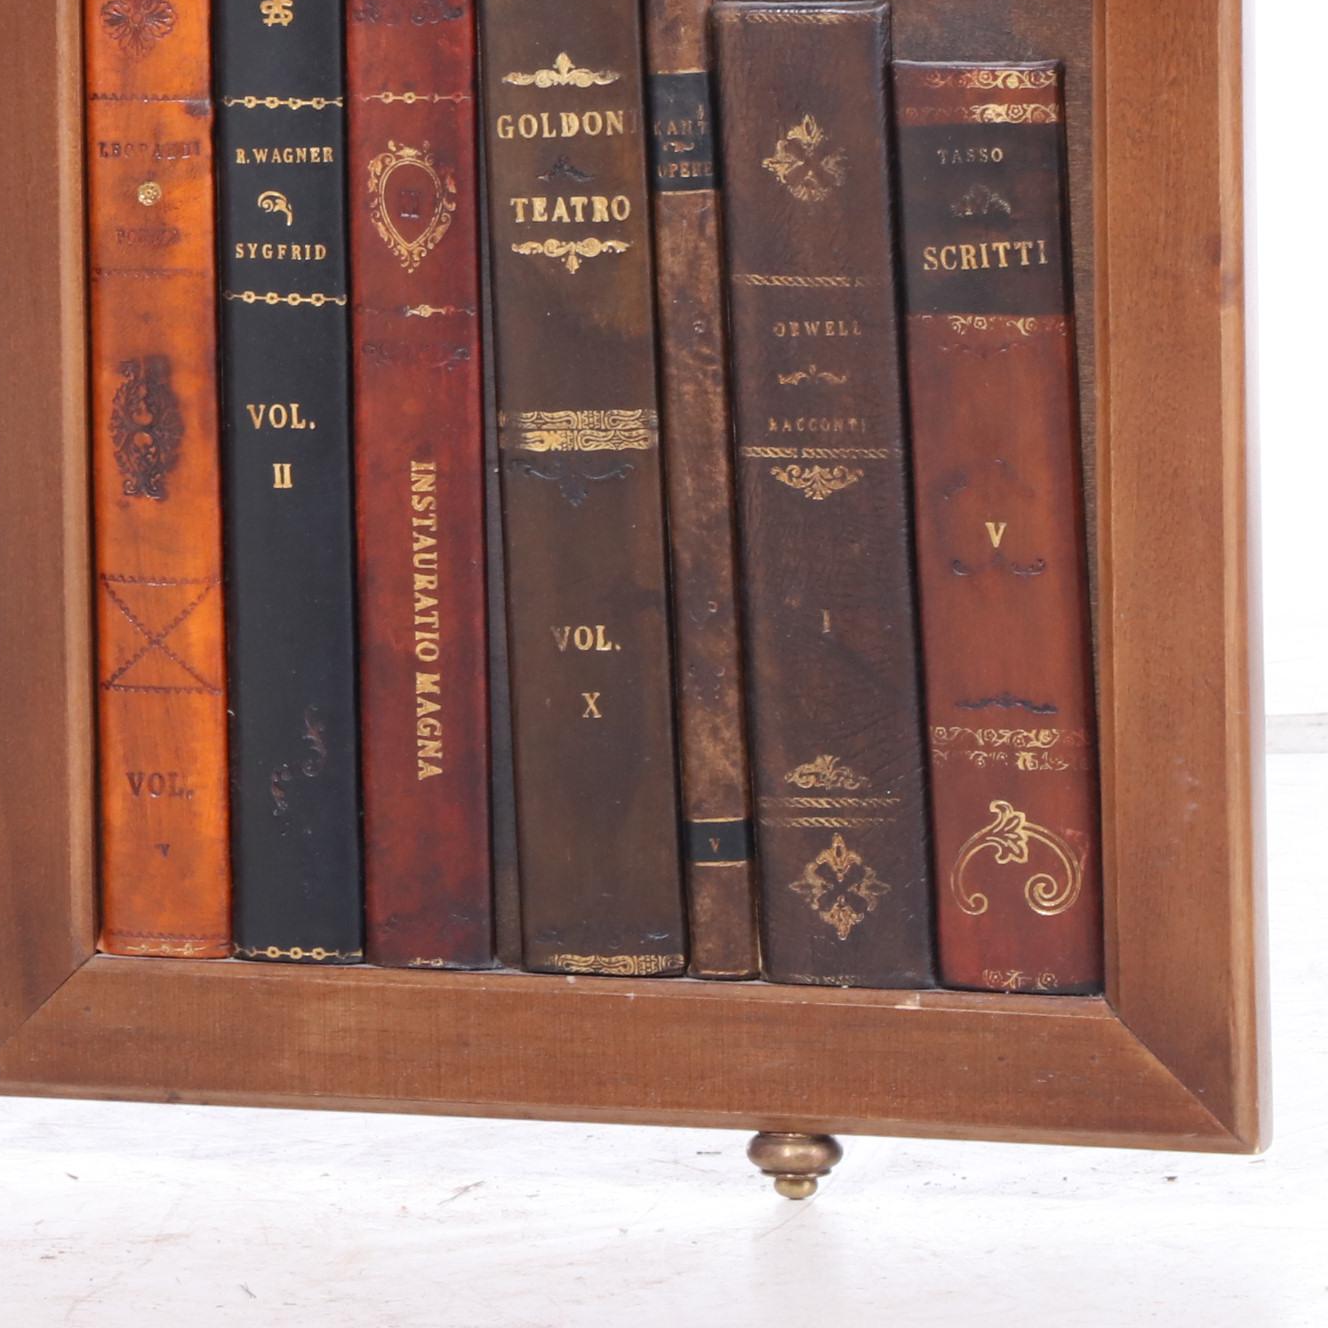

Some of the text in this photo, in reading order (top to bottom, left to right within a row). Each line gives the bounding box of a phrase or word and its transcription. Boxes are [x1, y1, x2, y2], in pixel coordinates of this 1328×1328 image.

[936, 147, 1004, 165] TASSO
[510, 194, 632, 224] TEATRO
[235, 242, 327, 261] SYGFRID
[922, 239, 1049, 271] SCRITTI
[772, 319, 863, 338] ORWELL
[247, 403, 317, 431] VOL.
[272, 462, 293, 490] II
[985, 521, 1007, 549] V
[408, 459, 443, 782] INSTAURATIO MAGNA
[550, 623, 622, 653] VOL.
[581, 691, 602, 719] X
